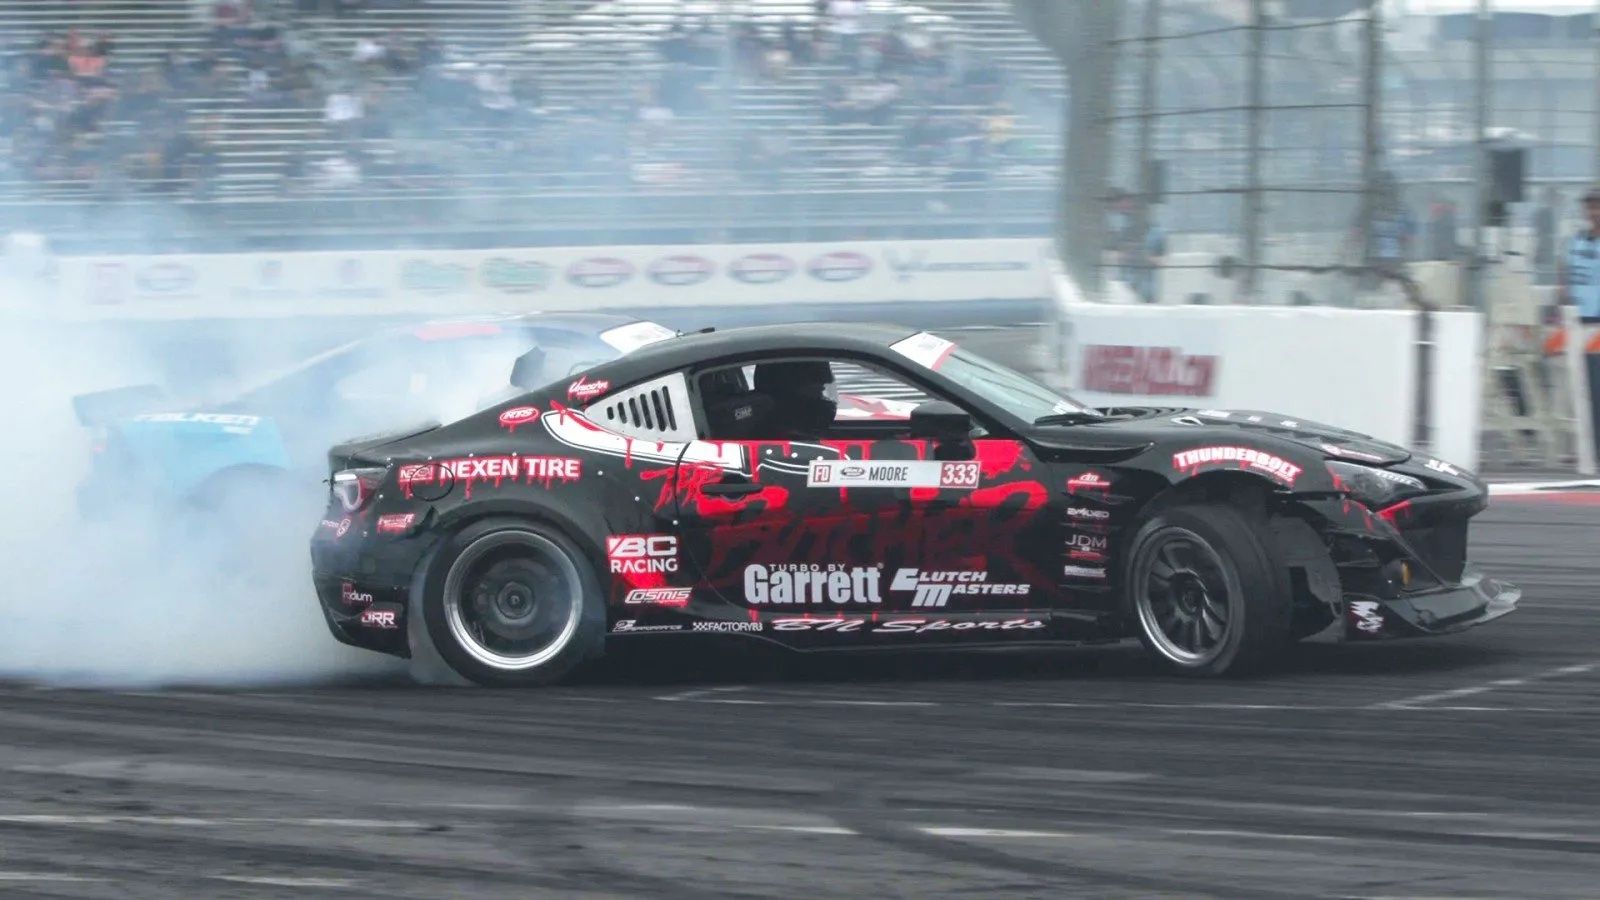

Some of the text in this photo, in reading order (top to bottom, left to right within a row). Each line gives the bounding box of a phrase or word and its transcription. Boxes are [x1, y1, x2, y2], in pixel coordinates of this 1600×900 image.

[440, 458, 519, 479] NEXEN
[524, 457, 580, 477] TIRE
[1173, 446, 1303, 479] THUNDERBOLT
[814, 465, 830, 482] FD
[868, 466, 909, 481] MOORE
[942, 463, 977, 485] 333
[1065, 534, 1108, 549] JDM
[610, 557, 678, 573] RACING
[770, 564, 820, 572] TURBO
[743, 563, 882, 604] Garrett
[890, 568, 987, 590] CLUTCH
[624, 587, 694, 604] COSMIS
[911, 584, 1031, 607] MASTERS
[871, 617, 1048, 634] Sports
